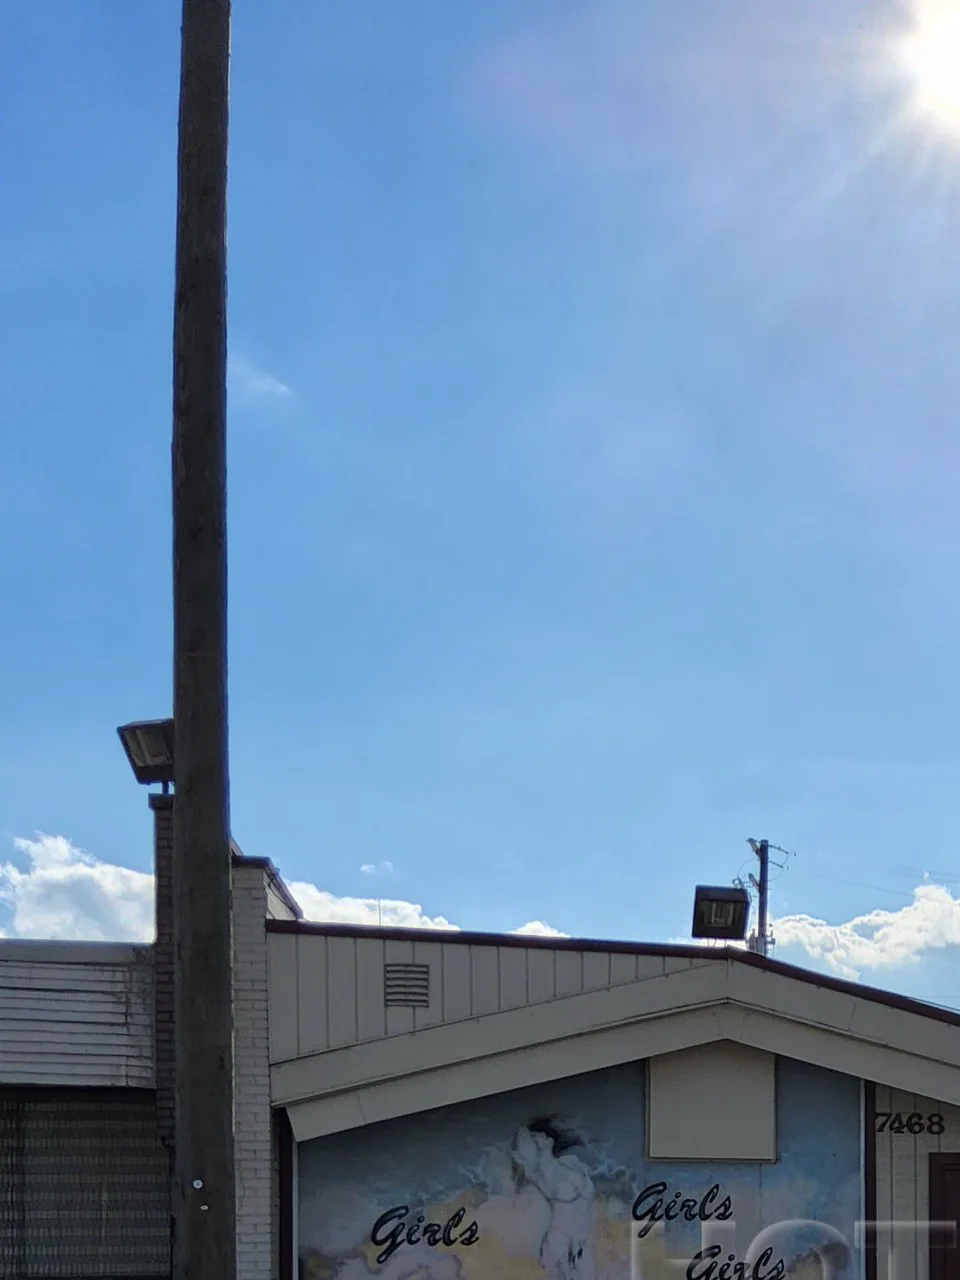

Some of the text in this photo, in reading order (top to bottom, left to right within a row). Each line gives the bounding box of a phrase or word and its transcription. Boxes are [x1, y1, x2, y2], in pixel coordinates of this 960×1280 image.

[874, 1111, 945, 1135] 7468
[371, 1205, 481, 1264] Girls
[632, 1181, 734, 1238] Girls
